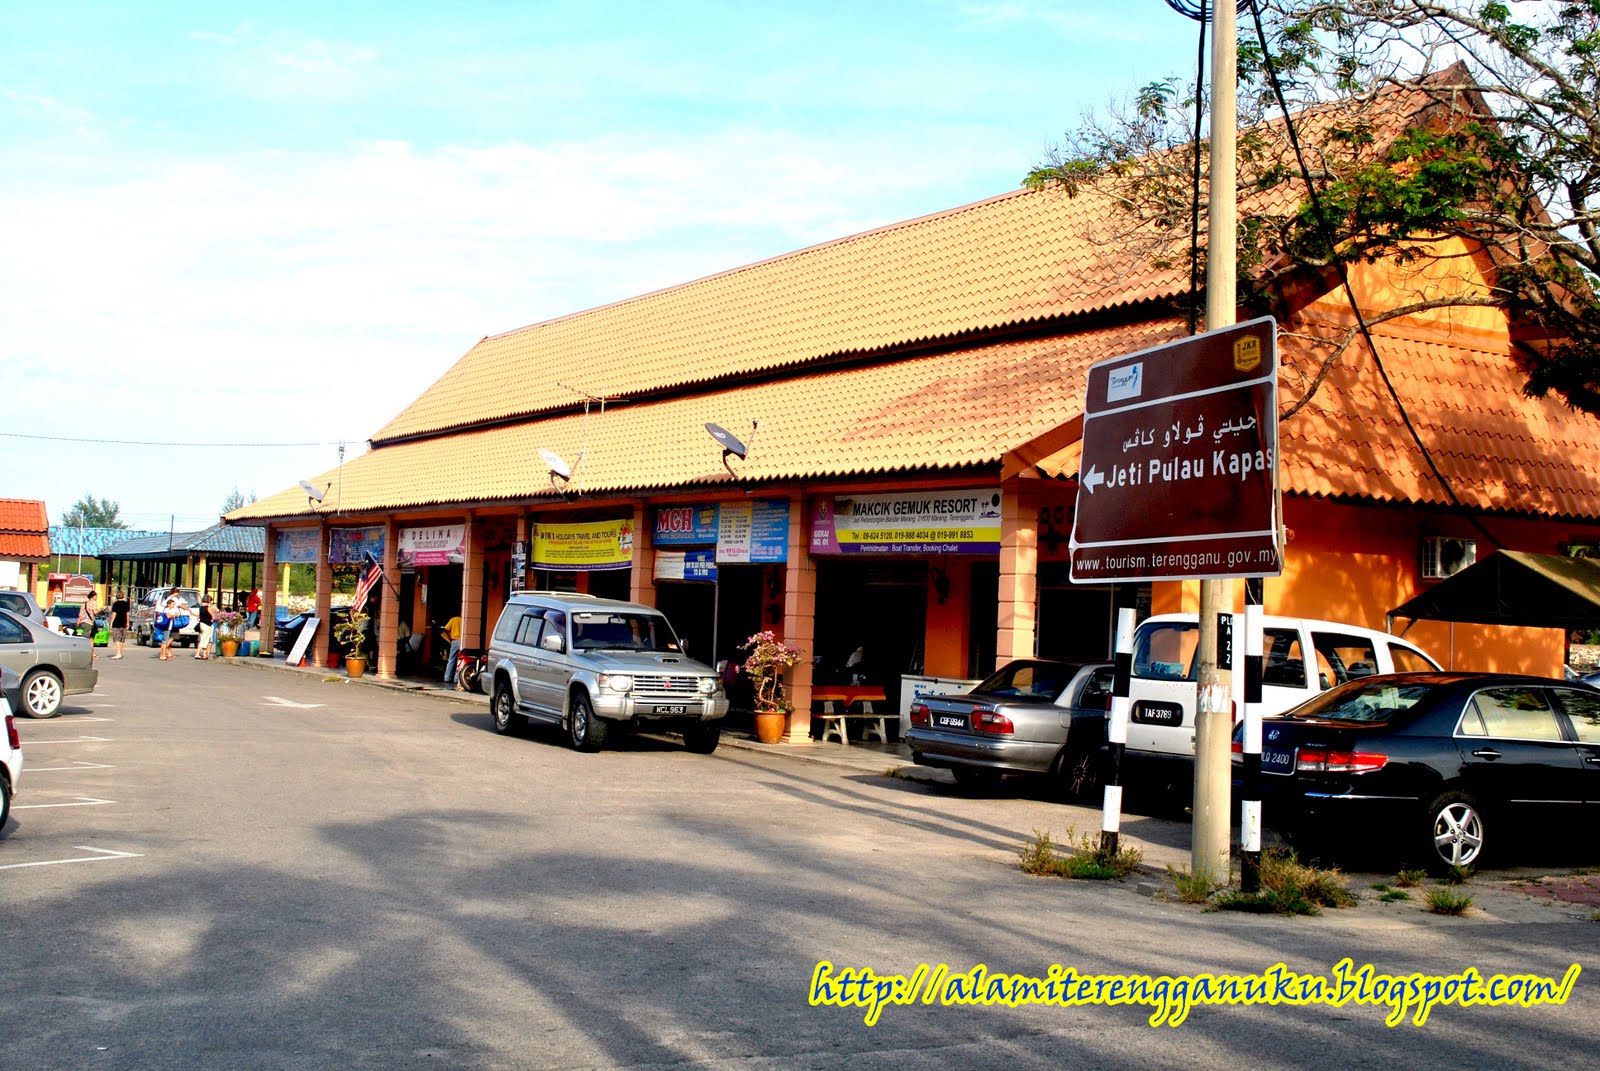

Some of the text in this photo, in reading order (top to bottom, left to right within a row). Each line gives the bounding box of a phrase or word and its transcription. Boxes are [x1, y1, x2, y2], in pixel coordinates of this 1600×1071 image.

[1242, 340, 1257, 351] JKR
[1106, 447, 1274, 488] Jeti Pulau Kapas
[852, 498, 978, 517] MAKCIK GEMUK RESORT
[656, 507, 694, 533] MGH
[813, 530, 829, 538] GERAI
[930, 530, 937, 541] @
[892, 544, 903, 552] Boat
[923, 544, 942, 553] Booking
[942, 544, 958, 552] Chalet
